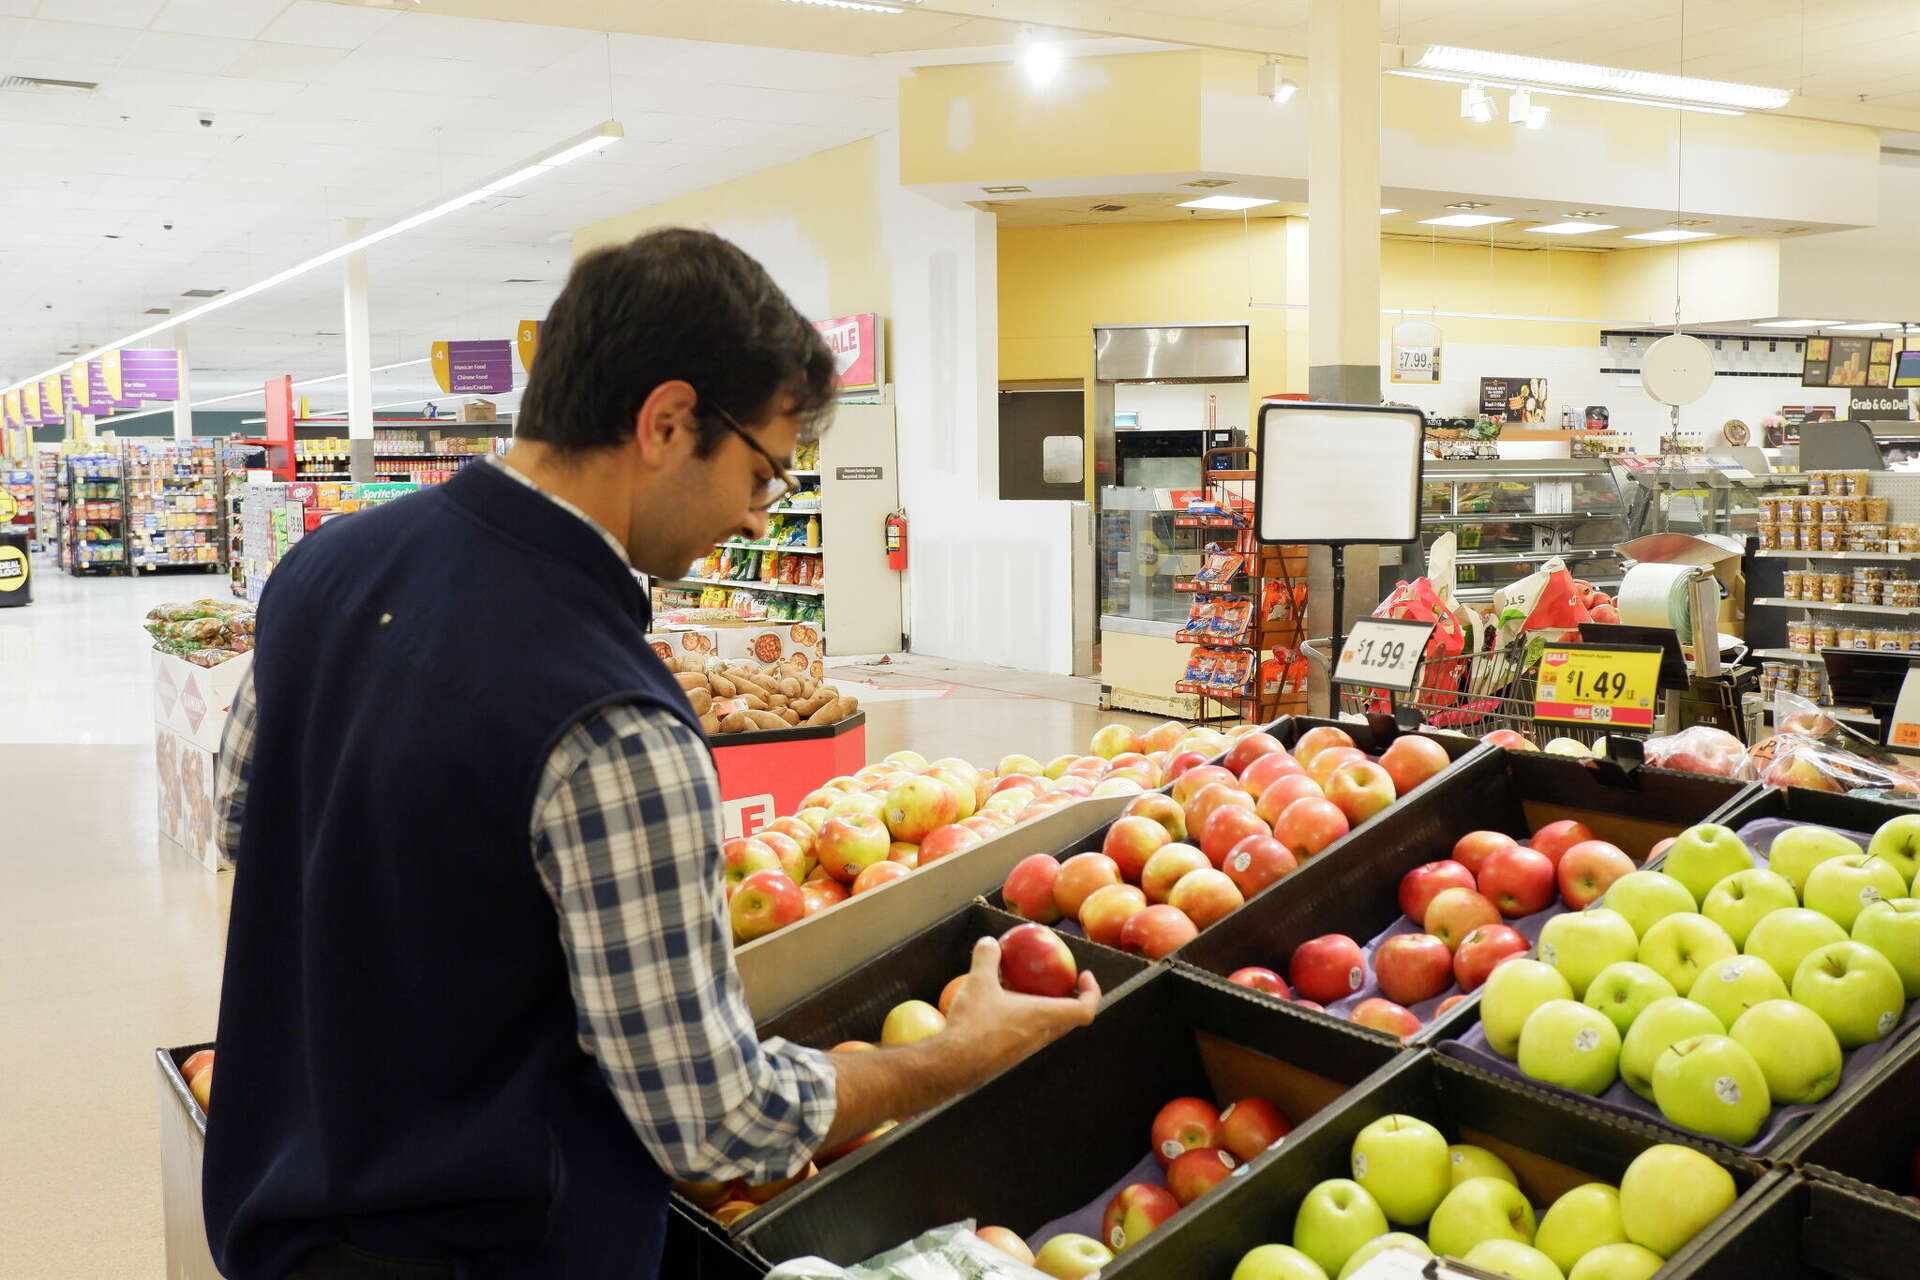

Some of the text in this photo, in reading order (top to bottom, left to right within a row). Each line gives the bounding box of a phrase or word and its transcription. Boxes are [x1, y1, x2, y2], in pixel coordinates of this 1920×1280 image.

[523, 330, 532, 342] 3
[829, 328, 858, 353] ALE
[436, 349, 444, 360] 4
[1851, 399, 1871, 410] Grab
[1872, 399, 1880, 410] &
[1880, 399, 1891, 410] Go
[362, 489, 392, 500] Sprite
[1357, 638, 1405, 669] $1.99
[1567, 669, 1626, 699] $1.49
